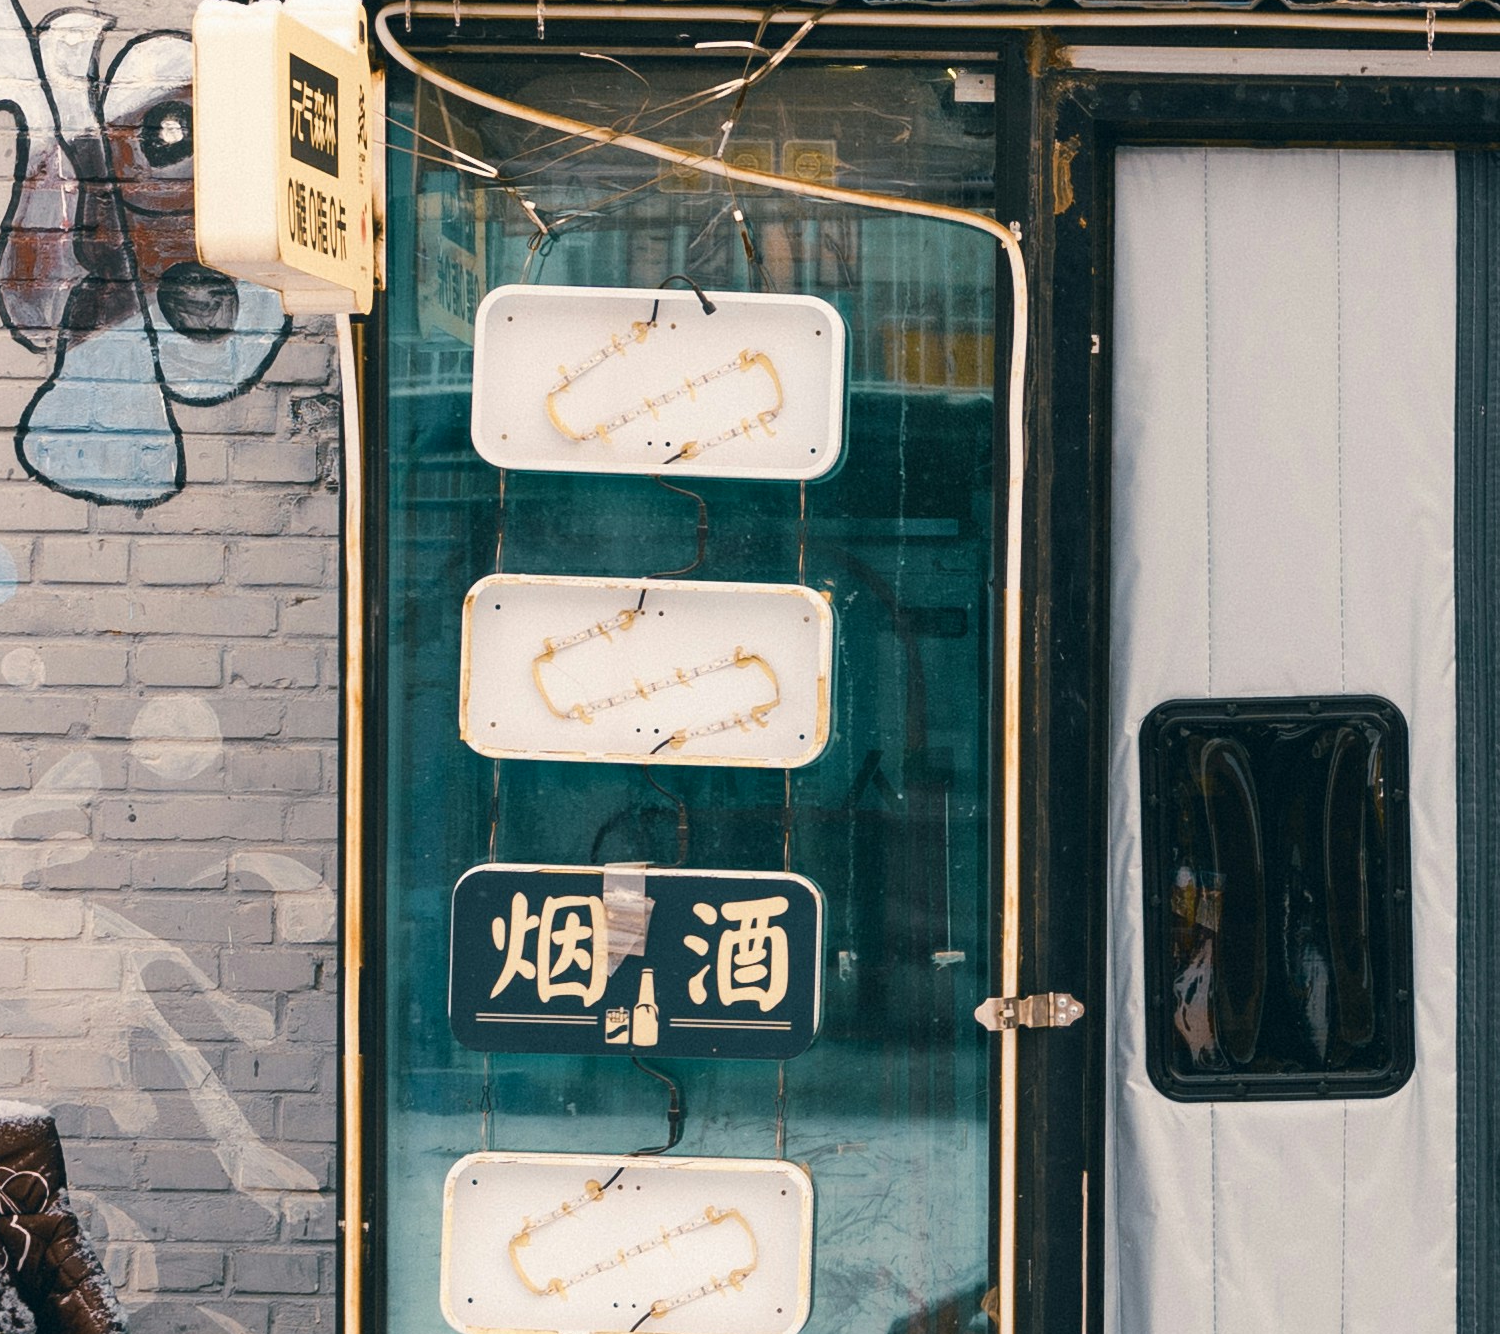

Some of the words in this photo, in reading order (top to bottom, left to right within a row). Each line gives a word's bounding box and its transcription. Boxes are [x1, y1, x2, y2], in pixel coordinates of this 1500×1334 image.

[290, 79, 336, 156] 元气森林
[287, 177, 348, 260] 0糖0脂0卡
[489, 891, 791, 1012] 烟酒
